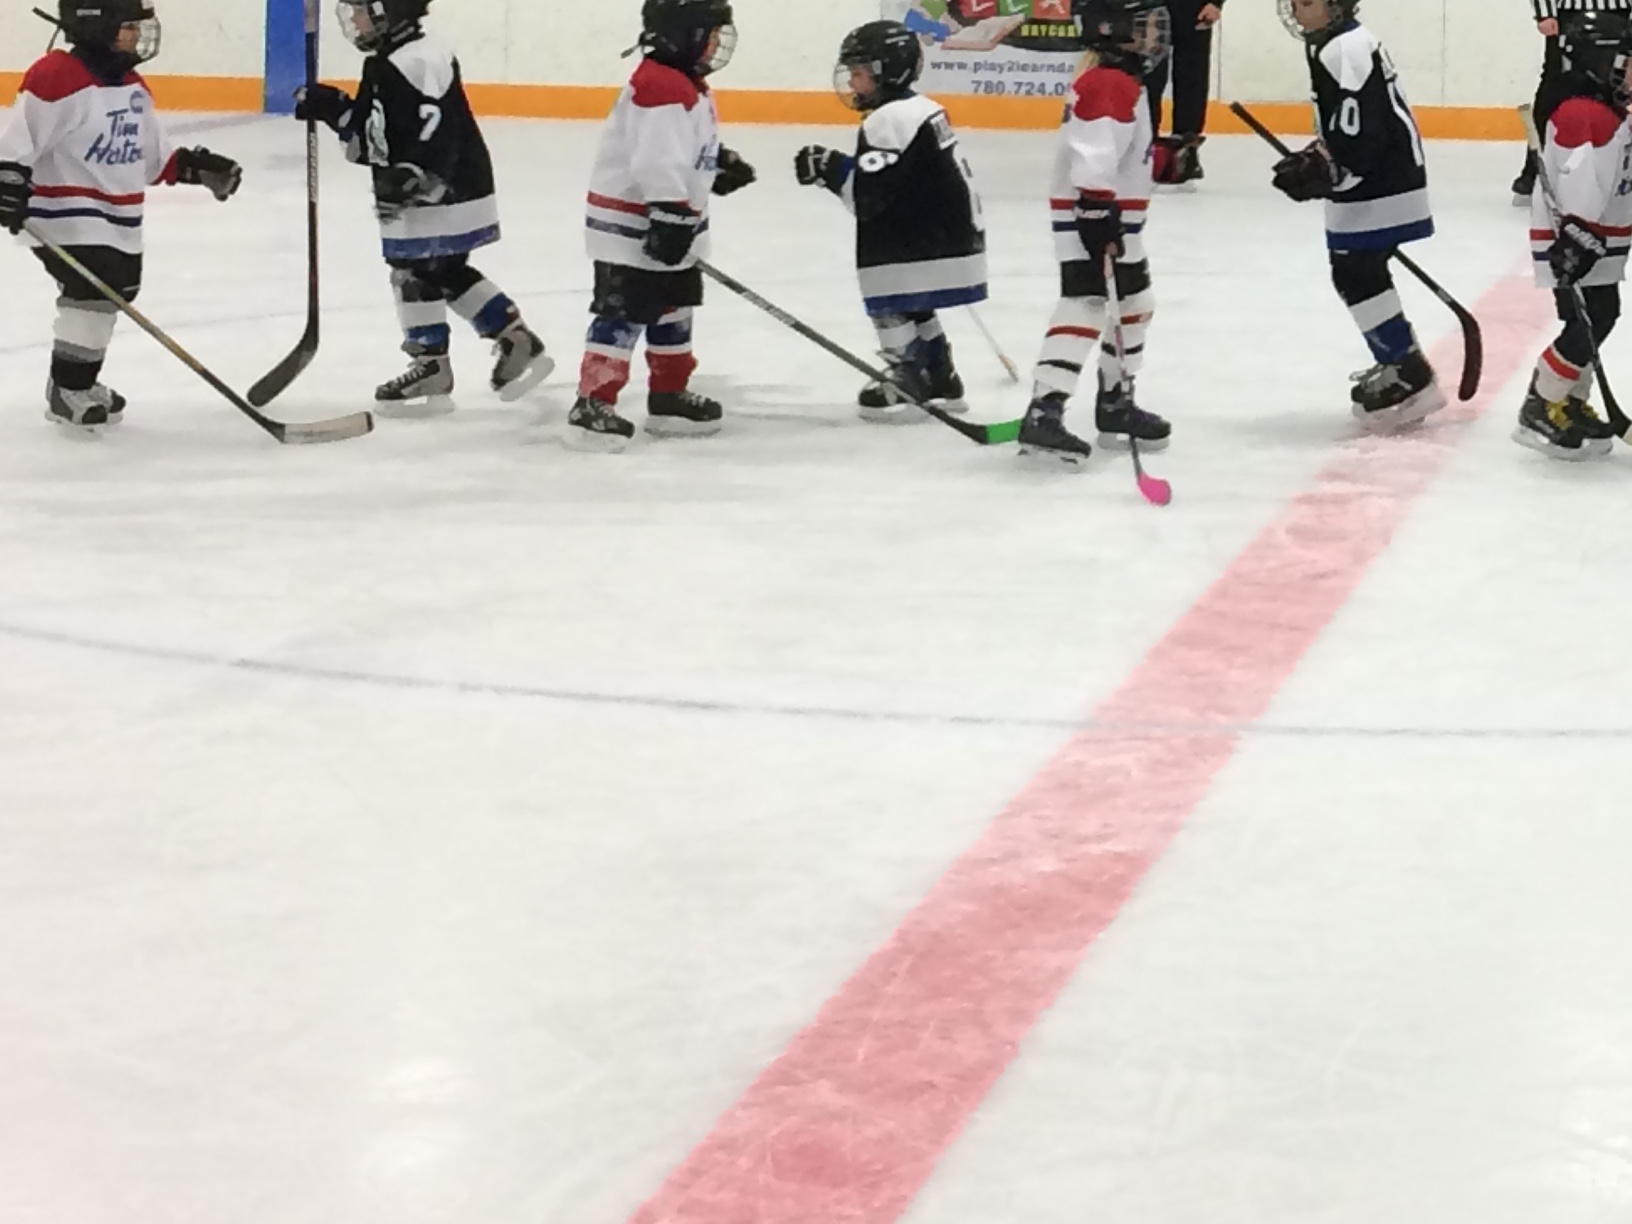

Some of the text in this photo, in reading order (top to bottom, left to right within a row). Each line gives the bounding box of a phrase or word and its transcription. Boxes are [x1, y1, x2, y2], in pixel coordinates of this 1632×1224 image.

[1020, 23, 1081, 38] DAYCAR
[970, 79, 1069, 97] 780.724.0
[105, 108, 139, 138] Tim
[418, 103, 443, 142] 7
